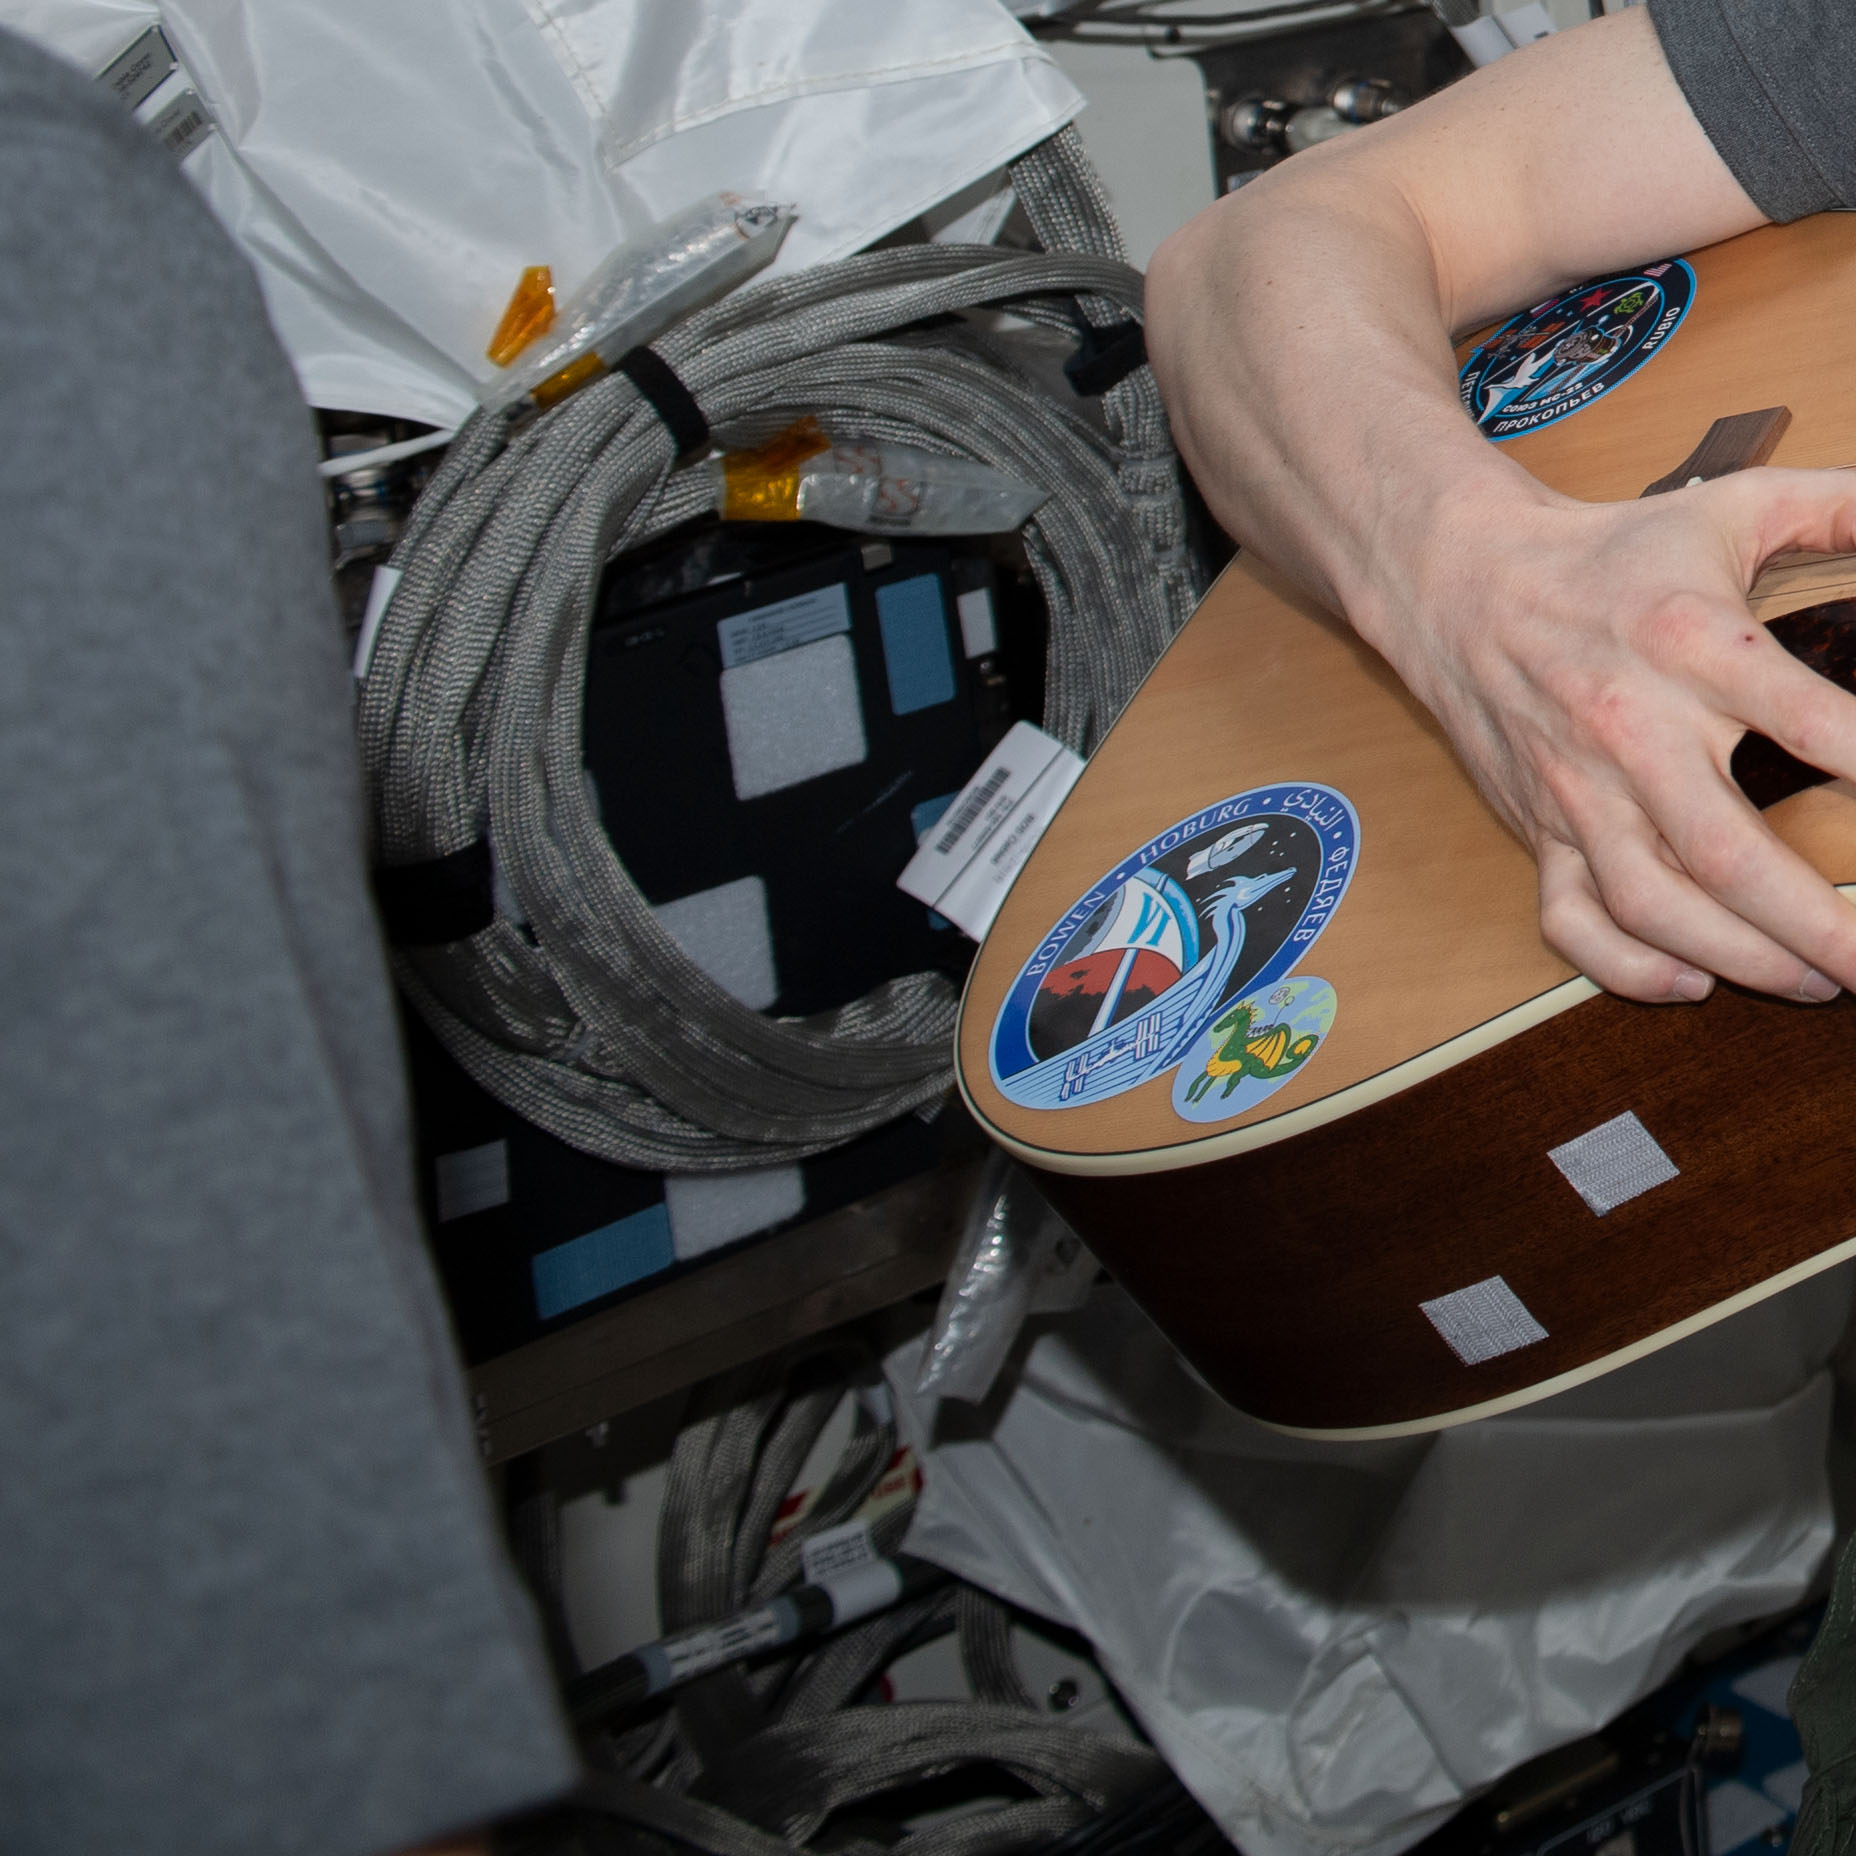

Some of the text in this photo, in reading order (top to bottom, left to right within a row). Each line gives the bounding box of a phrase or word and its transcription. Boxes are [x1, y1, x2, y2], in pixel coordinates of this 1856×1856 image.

[1642, 306, 1681, 350] RUBIO
[1493, 382, 1605, 433] ПРОКОПЬЕВ
[1139, 797, 1249, 865] HOBURG
[1292, 845, 1351, 943] ФЕДЯЕВ
[1026, 891, 1102, 978] BOWEN
